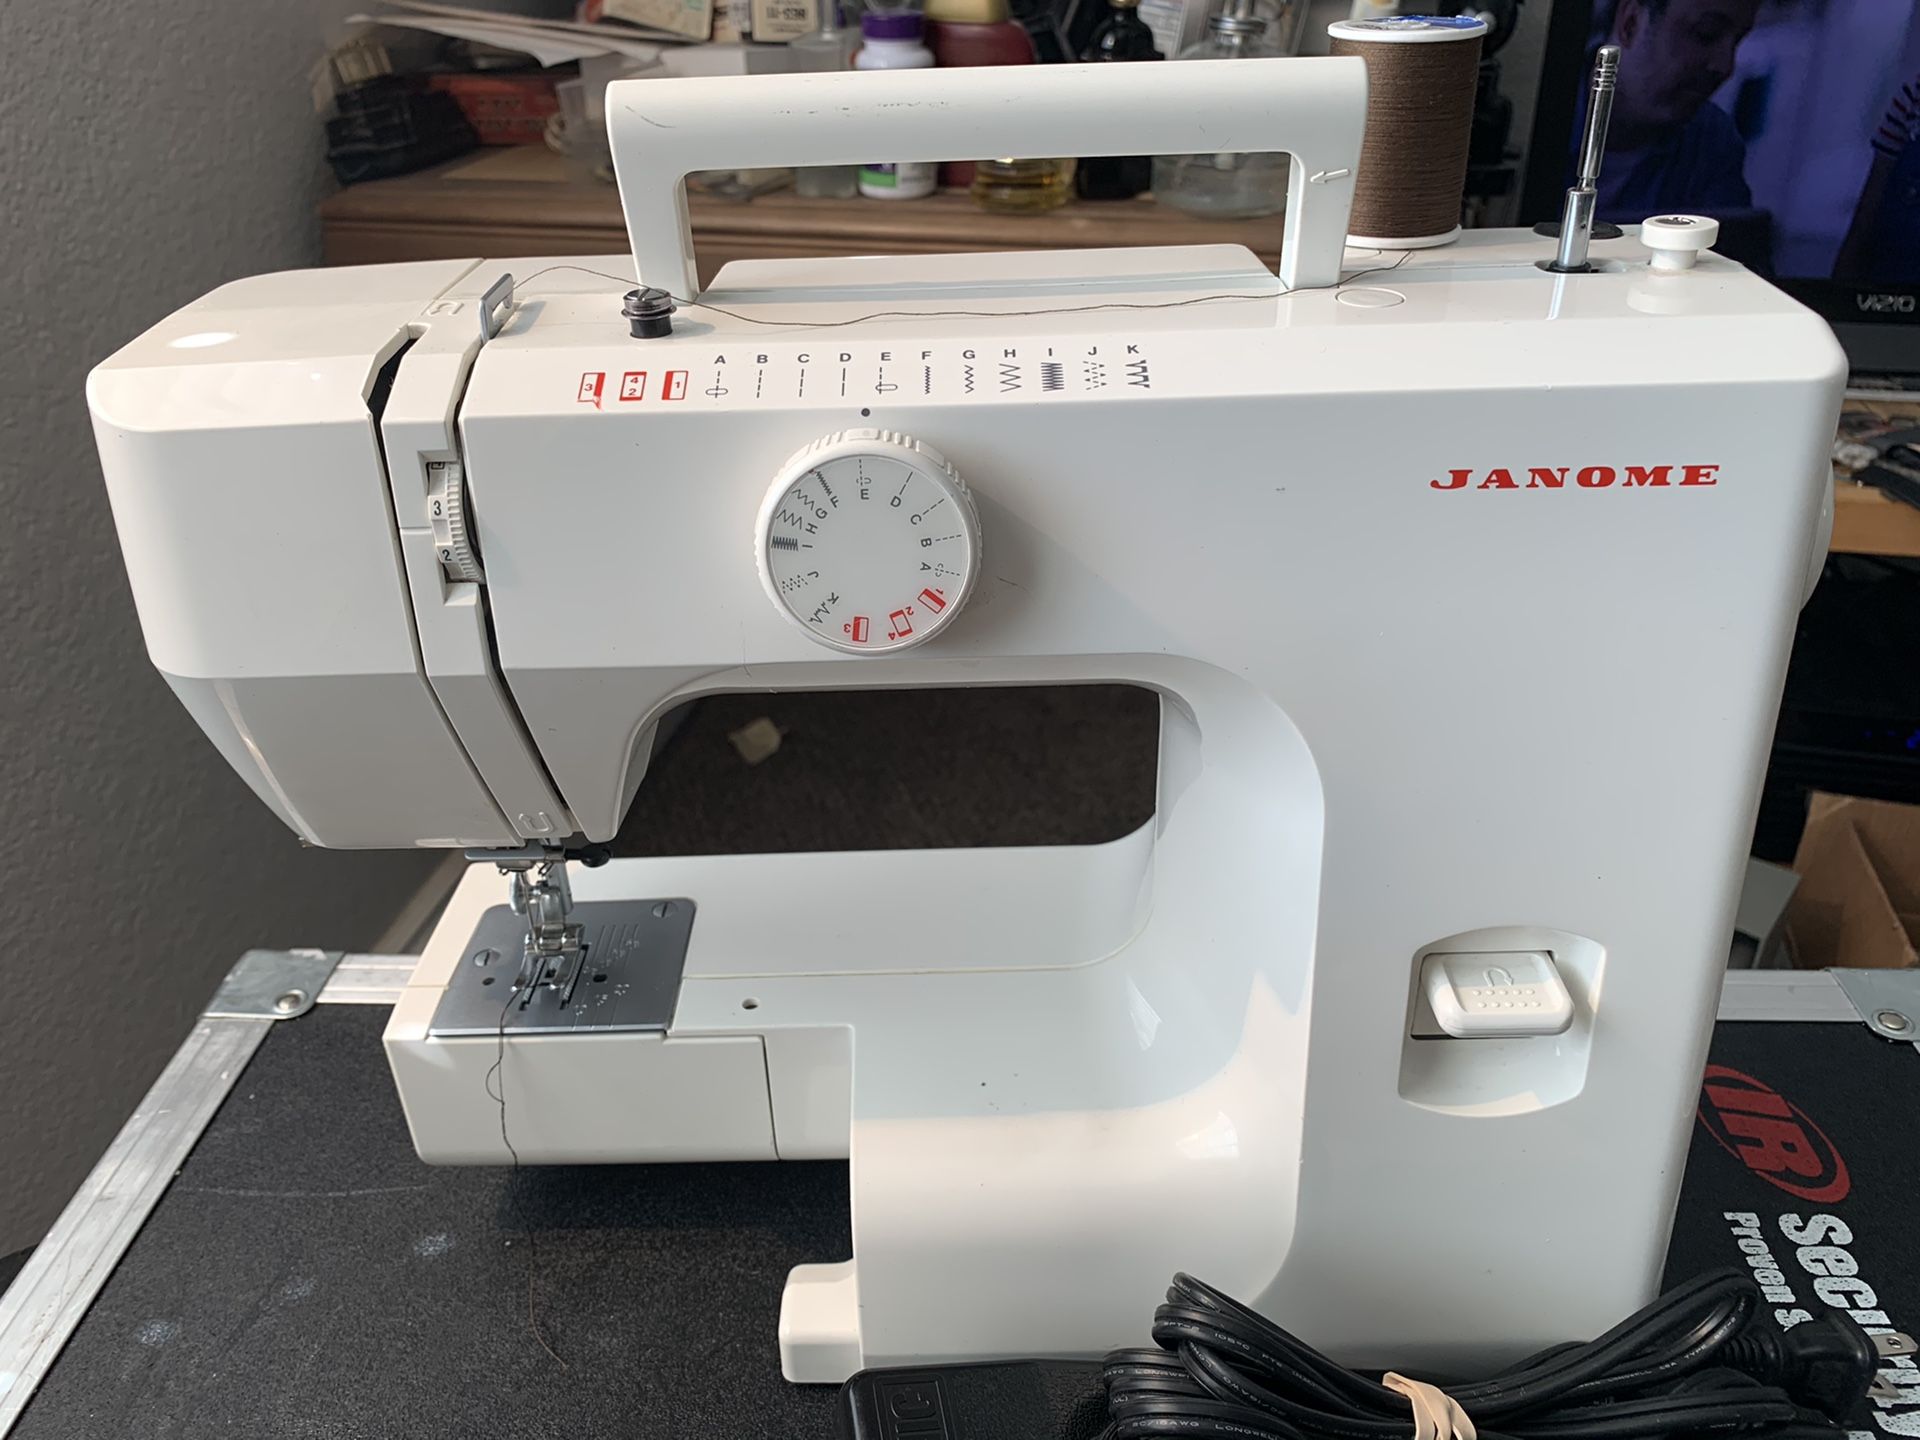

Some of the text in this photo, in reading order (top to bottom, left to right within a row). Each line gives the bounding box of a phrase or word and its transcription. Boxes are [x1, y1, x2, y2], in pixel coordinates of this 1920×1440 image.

[1857, 294, 1915, 312] VIZIO
[714, 355, 726, 364] A
[757, 354, 768, 364] B
[797, 354, 810, 363] C
[839, 353, 851, 362] D
[881, 352, 891, 361] E
[921, 351, 931, 360] F
[963, 350, 975, 359] G
[1004, 349, 1016, 358] H
[1088, 346, 1097, 356] J
[1127, 345, 1139, 354] K
[584, 383, 593, 391] 3
[628, 388, 637, 396] 2
[1430, 465, 1720, 490] JANOME
[860, 488, 870, 500] E
[433, 500, 442, 516] 3
[830, 495, 841, 508] F
[890, 495, 902, 508] D
[816, 507, 828, 520] G
[910, 514, 922, 526] C
[805, 522, 819, 535] H
[920, 537, 932, 548] B
[442, 549, 452, 561] 2
[920, 561, 932, 571] A
[807, 570, 819, 579] J
[827, 592, 840, 605] K
[905, 606, 915, 616] 2
[843, 623, 851, 633] 3
[888, 632, 896, 641] 4
[1703, 1085, 1823, 1178] IR
[1723, 1212, 1796, 1303] Proven
[1683, 1343, 1707, 1359] TYPE
